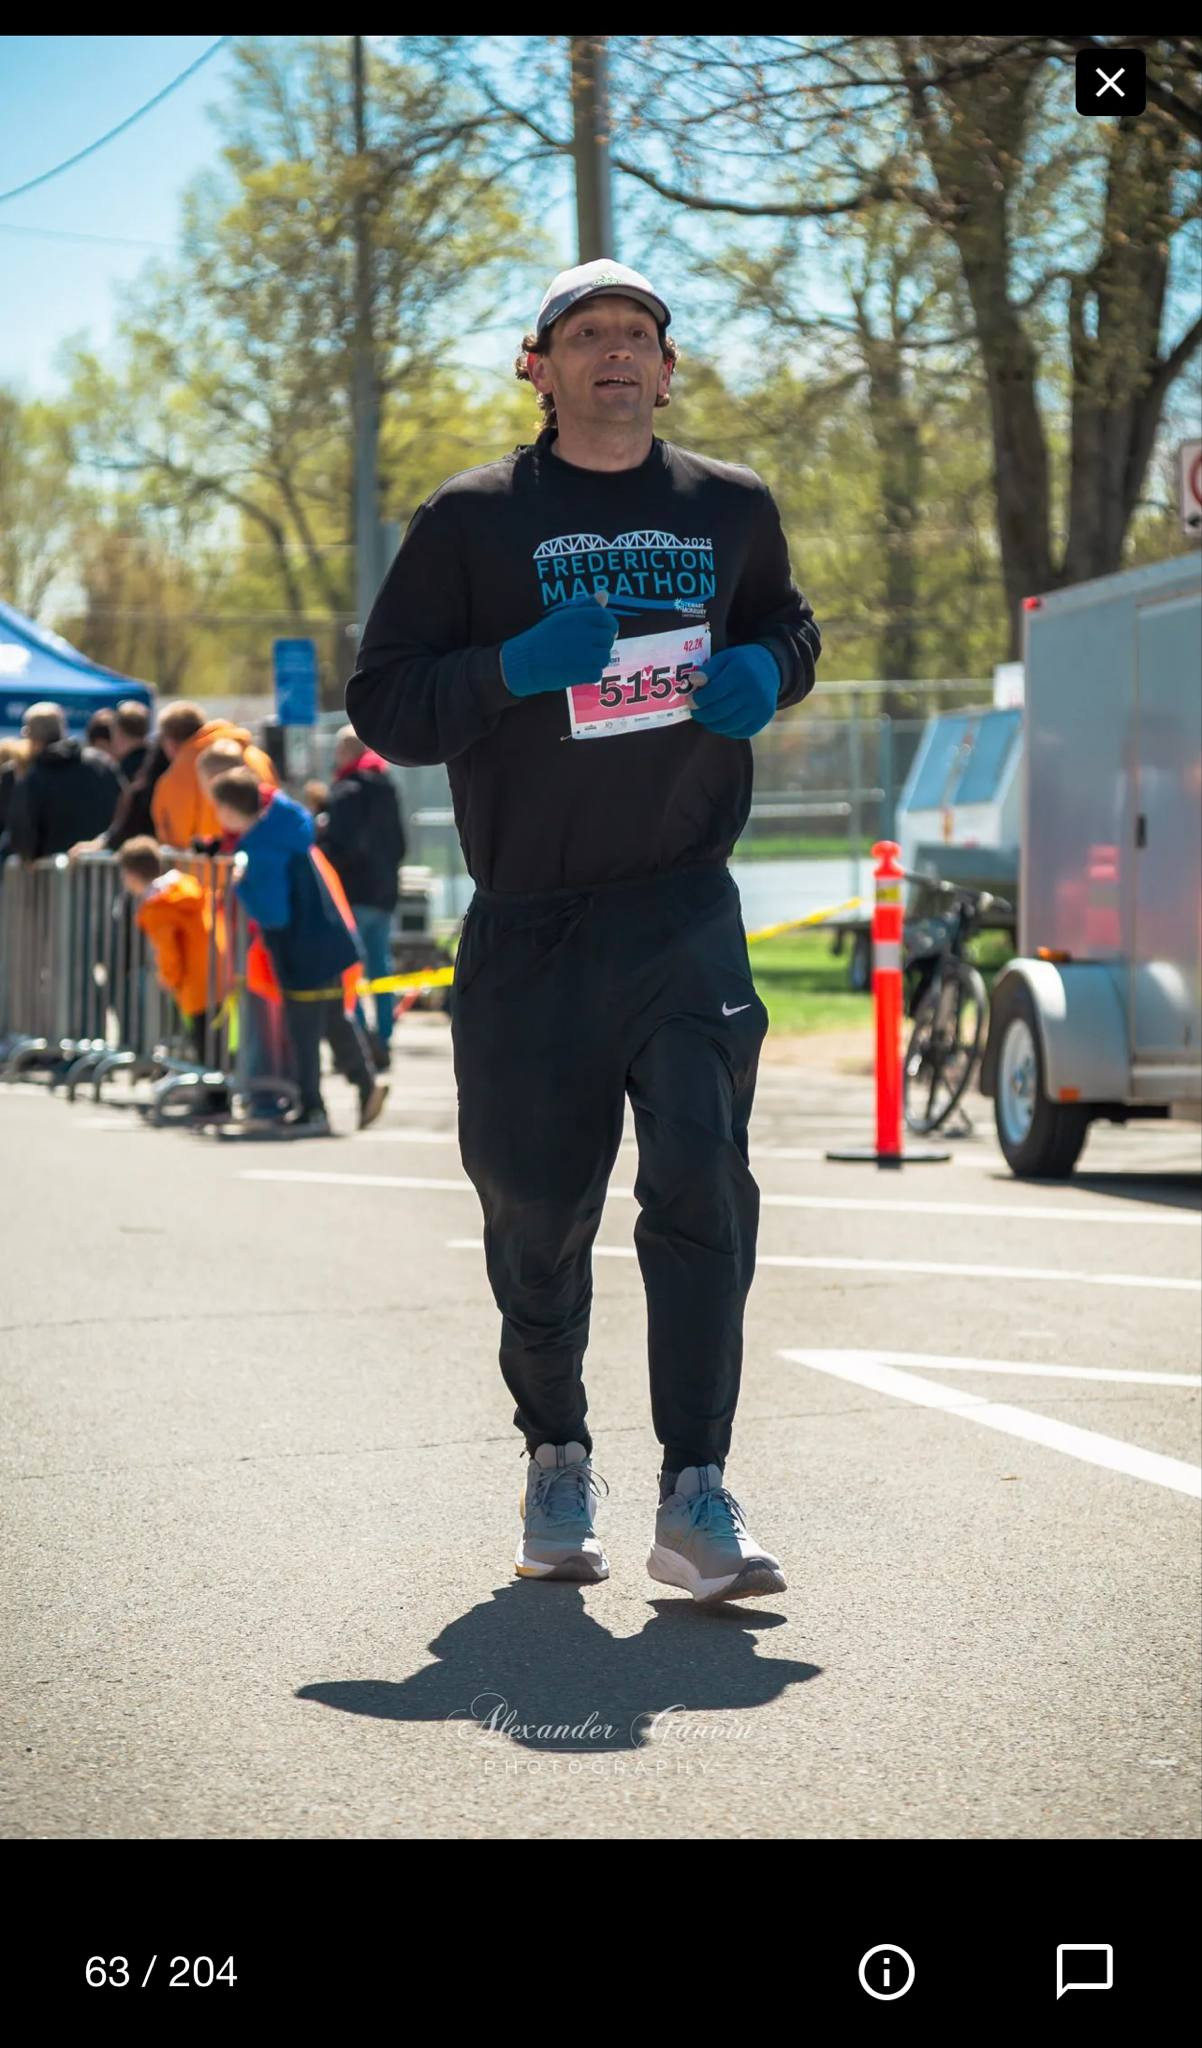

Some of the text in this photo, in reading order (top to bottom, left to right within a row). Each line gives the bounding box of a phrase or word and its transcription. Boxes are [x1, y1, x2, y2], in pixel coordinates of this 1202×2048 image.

[682, 537, 713, 548] 2025
[536, 550, 715, 580] FREDERICTON
[540, 571, 717, 606] MARATHON
[683, 637, 704, 652] 42.2K
[599, 661, 694, 708] 5155
